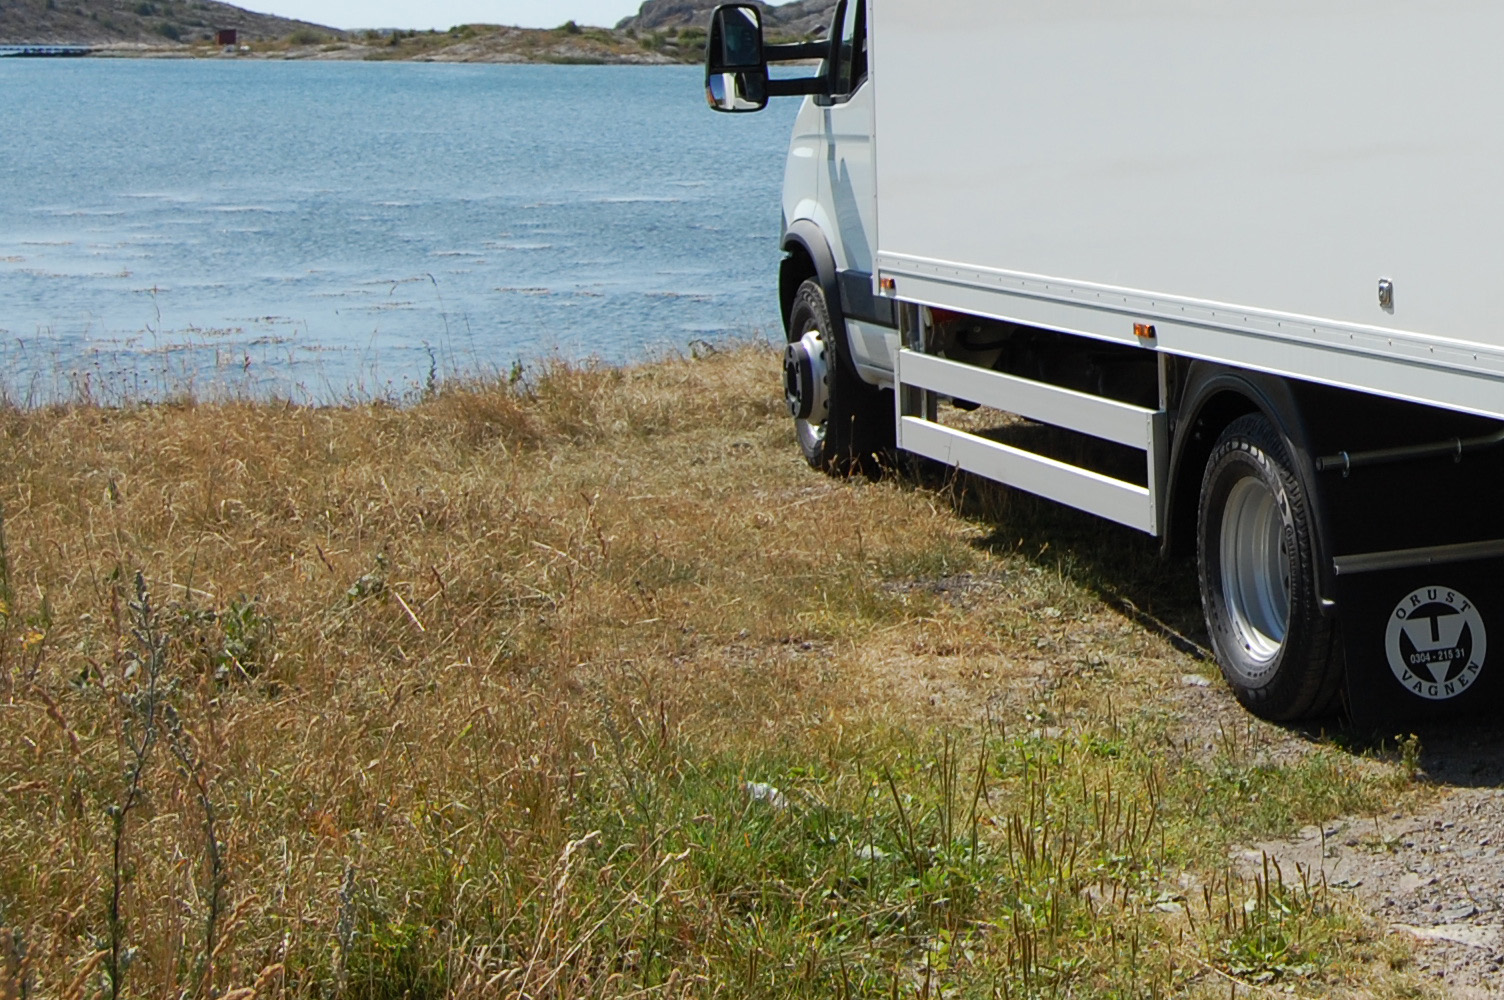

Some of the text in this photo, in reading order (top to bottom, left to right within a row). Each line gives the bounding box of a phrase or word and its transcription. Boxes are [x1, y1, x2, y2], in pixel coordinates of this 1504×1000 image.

[1396, 588, 1472, 620] ORUST
[1410, 652, 1431, 664] 0304
[1401, 660, 1480, 697] VAGNEN
